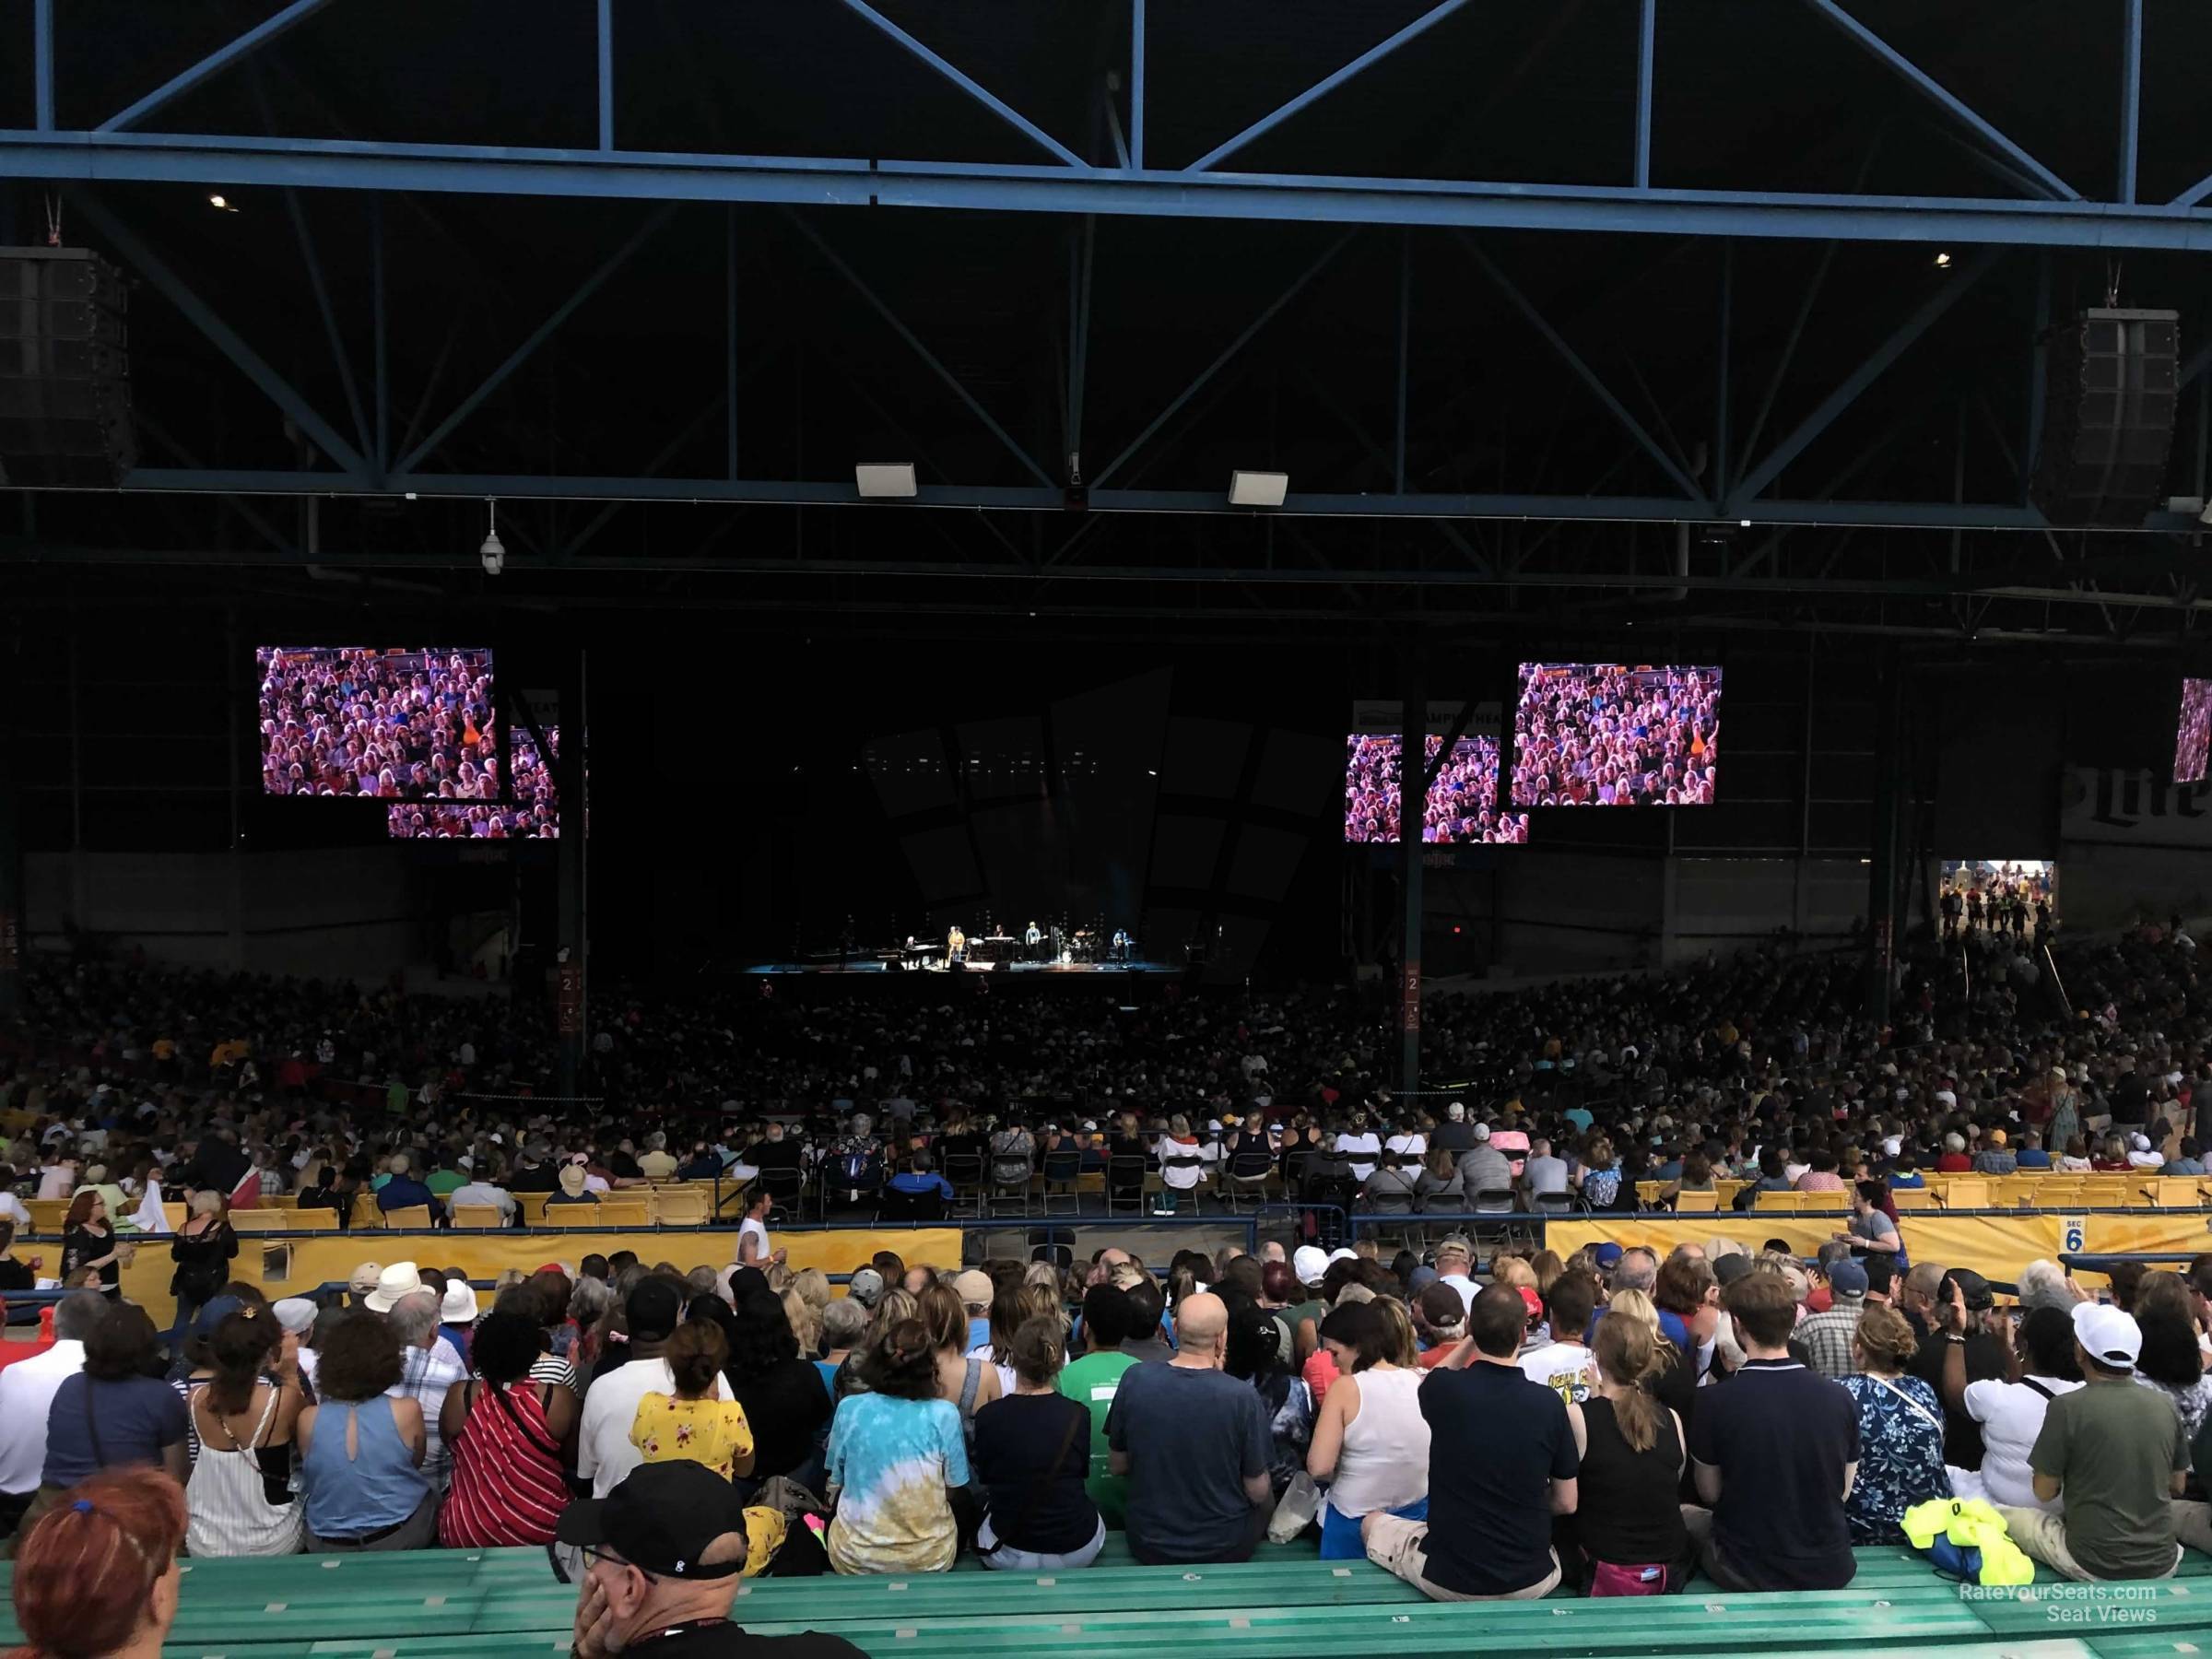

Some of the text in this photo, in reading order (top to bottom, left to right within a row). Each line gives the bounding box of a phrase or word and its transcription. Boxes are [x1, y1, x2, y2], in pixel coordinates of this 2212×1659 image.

[562, 978, 572, 991] 2
[1408, 977, 1418, 990] 2
[2066, 1229, 2083, 1252] 6
